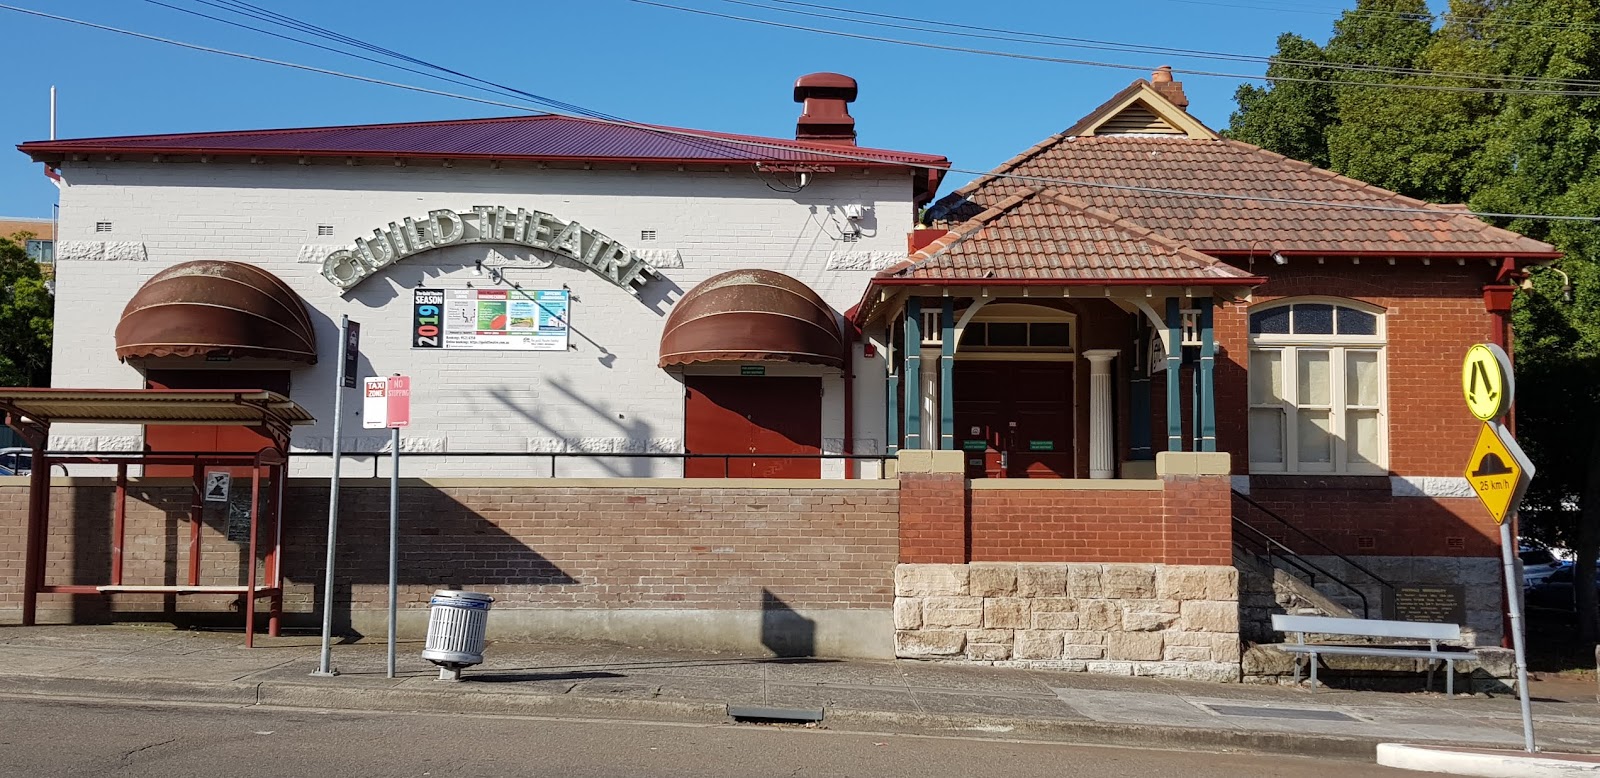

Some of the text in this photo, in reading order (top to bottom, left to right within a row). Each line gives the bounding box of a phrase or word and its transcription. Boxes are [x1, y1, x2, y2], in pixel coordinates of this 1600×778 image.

[323, 205, 662, 295] GUILD THEATRE
[415, 295, 443, 305] SEASON
[418, 305, 440, 347] 2019
[367, 382, 385, 390] TAXI
[393, 379, 404, 389] NO
[388, 389, 410, 397] STOPPING
[1480, 479, 1510, 491] 25 km/h
